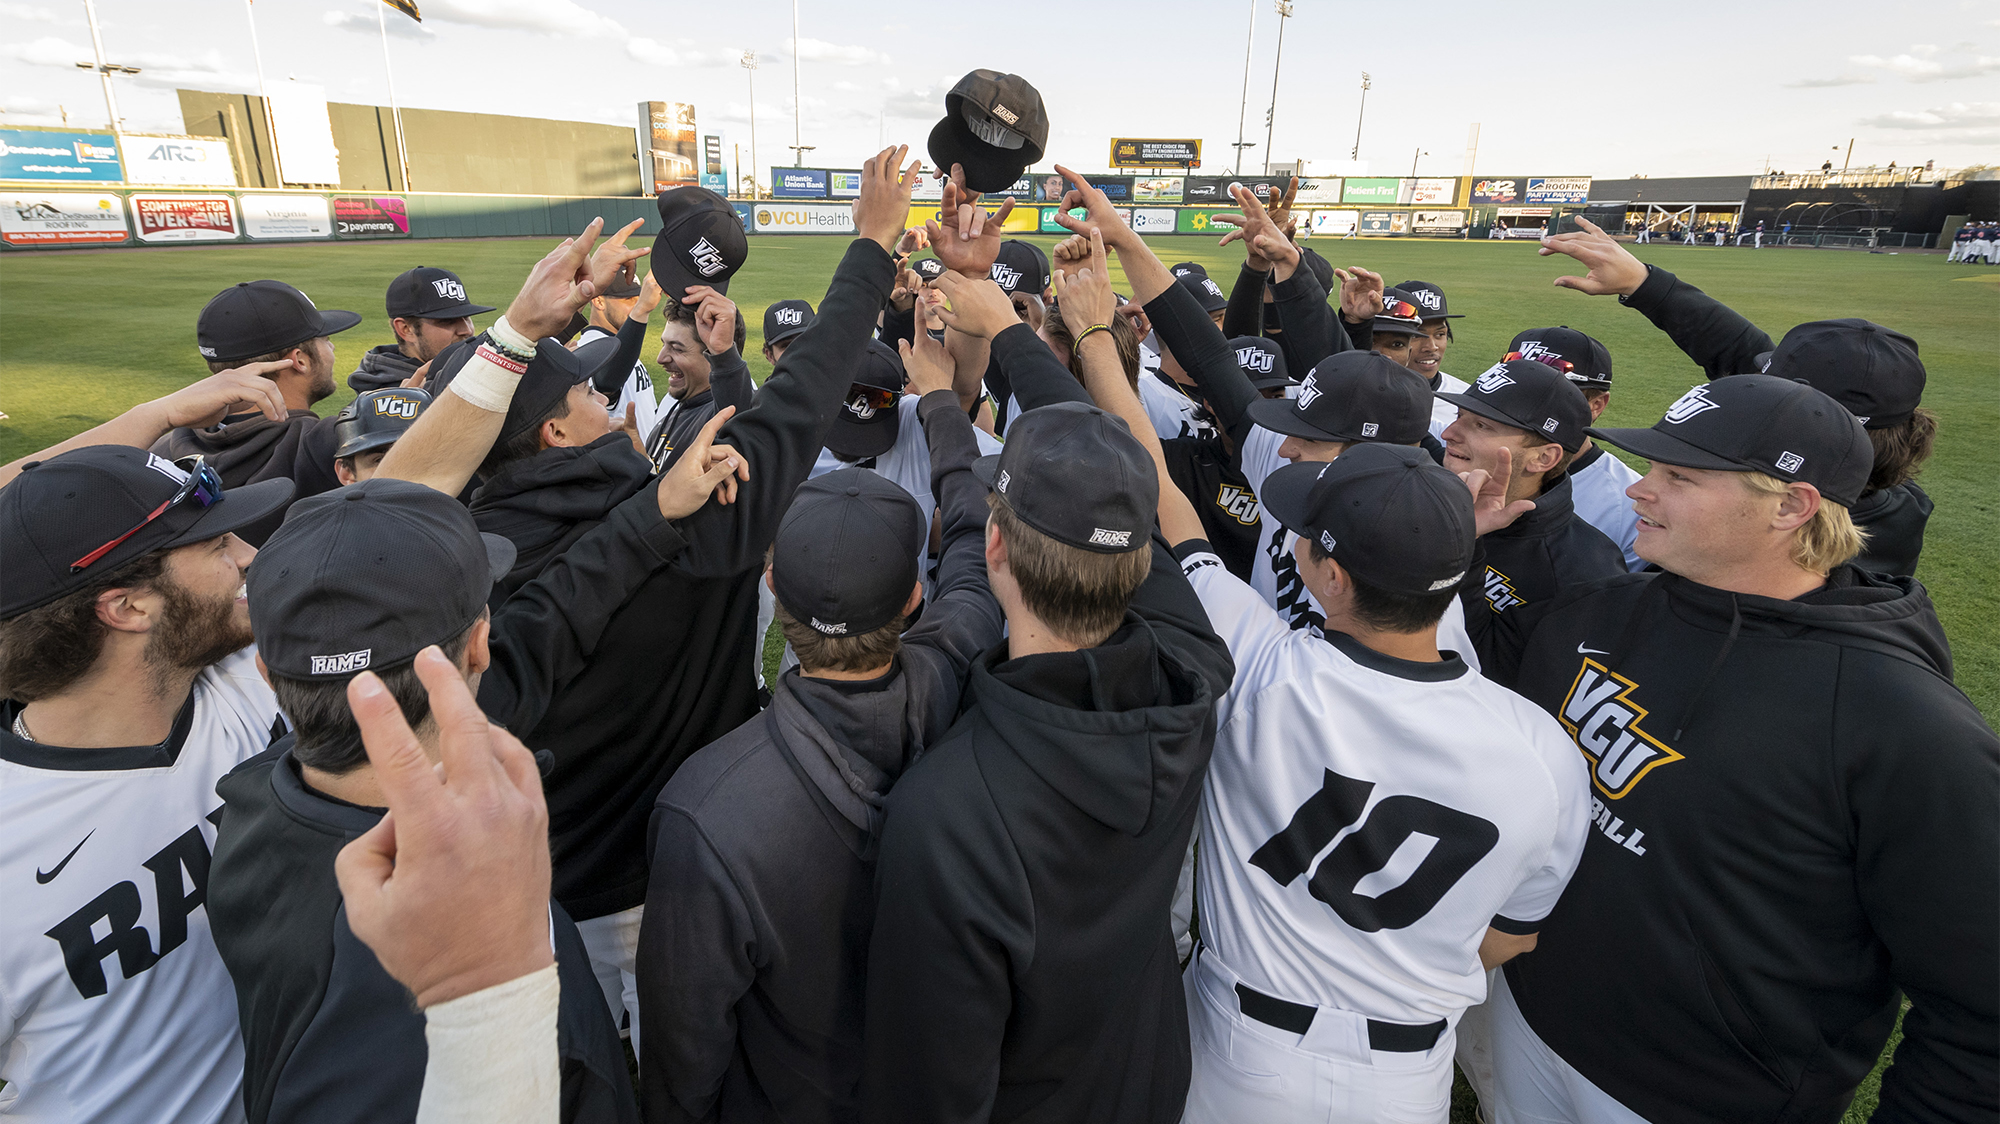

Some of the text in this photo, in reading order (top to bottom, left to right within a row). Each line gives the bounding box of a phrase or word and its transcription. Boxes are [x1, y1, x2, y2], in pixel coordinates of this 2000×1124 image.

[992, 104, 1019, 125] RAMS
[1345, 186, 1395, 195] Patient First
[1494, 180, 1516, 191] 12
[140, 200, 227, 213] SOMETHING FOR
[265, 208, 308, 218] Virginia
[334, 200, 366, 208] finance
[335, 208, 382, 216] automation
[45, 221, 89, 229] ROOFING
[349, 222, 395, 232] paymerang
[1148, 217, 1170, 226] CoStar
[689, 237, 728, 277] VCU
[921, 260, 941, 273] VCU
[990, 263, 1022, 290] VCU
[432, 278, 466, 301] VCU
[1412, 289, 1441, 310] VCU
[774, 307, 803, 327] VCU
[1236, 346, 1275, 373] VCU
[373, 396, 420, 420] VCU
[1216, 484, 1260, 525] VCU
[1089, 528, 1132, 546] RAMS
[1484, 568, 1524, 613] VCU
[812, 617, 848, 635] RAMS
[311, 649, 372, 675] RAMS
[1562, 662, 1668, 793] VCU
[1247, 766, 1500, 933] 10
